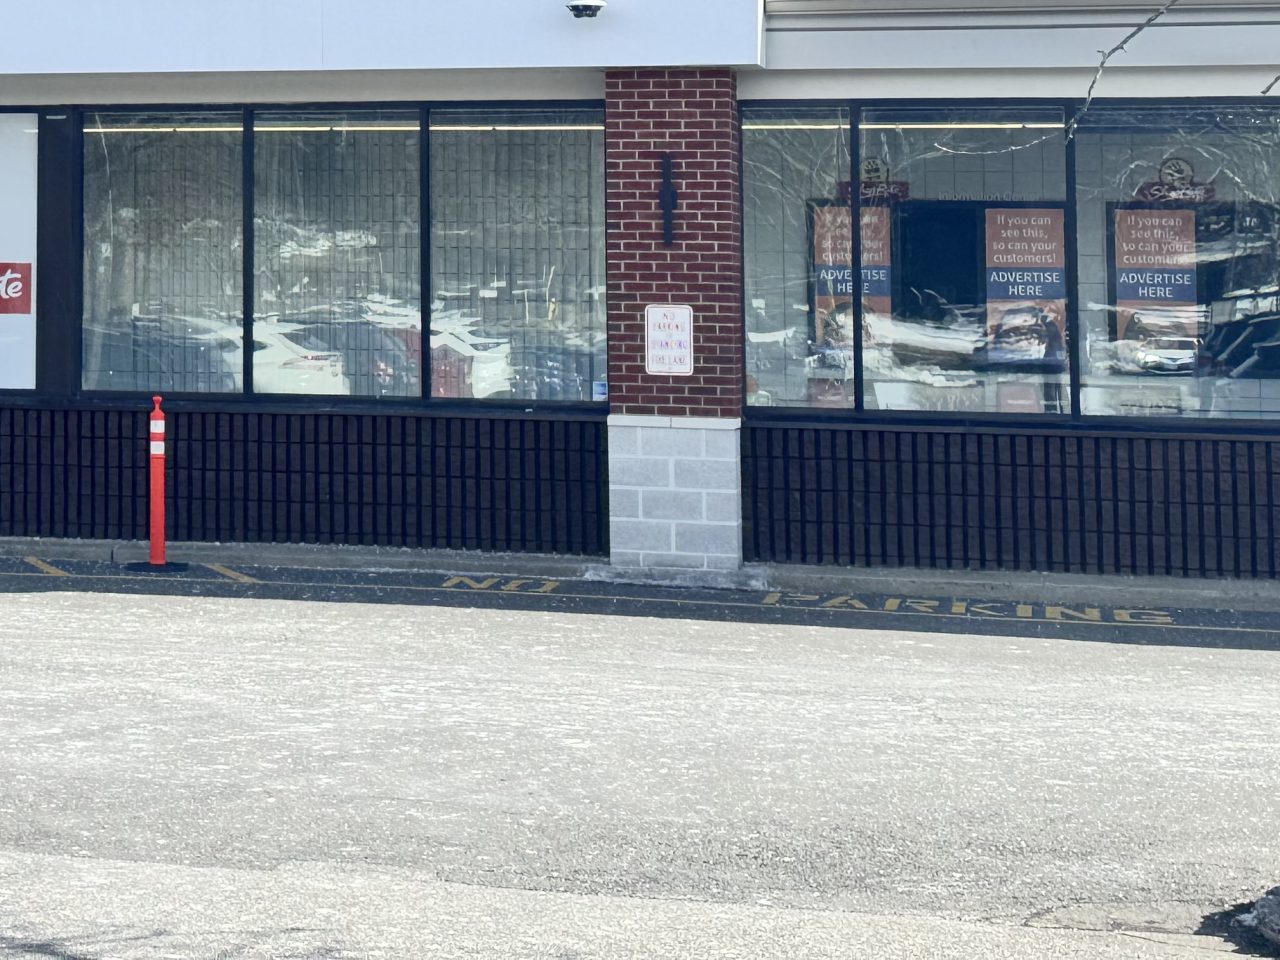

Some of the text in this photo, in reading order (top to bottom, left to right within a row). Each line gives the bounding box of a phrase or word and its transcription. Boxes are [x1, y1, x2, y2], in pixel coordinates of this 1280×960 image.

[997, 215, 1051, 227] If you can
[1137, 217, 1159, 228] you
[1161, 217, 1182, 227] can
[1000, 228, 1048, 239] see this,
[993, 242, 1057, 252] so can your
[1138, 242, 1159, 251] can
[1162, 243, 1189, 253] your
[822, 251, 883, 261] custoers!
[993, 253, 1056, 263] customers!
[820, 270, 887, 281] ADVETISE
[990, 272, 1060, 282] ADVERTISE
[1120, 273, 1191, 284] ADVERTISE
[837, 283, 870, 293] HEE
[1008, 285, 1043, 296] HERE
[1138, 287, 1173, 298] HERE
[442, 576, 560, 593] NO
[762, 592, 1174, 624] PARKING
